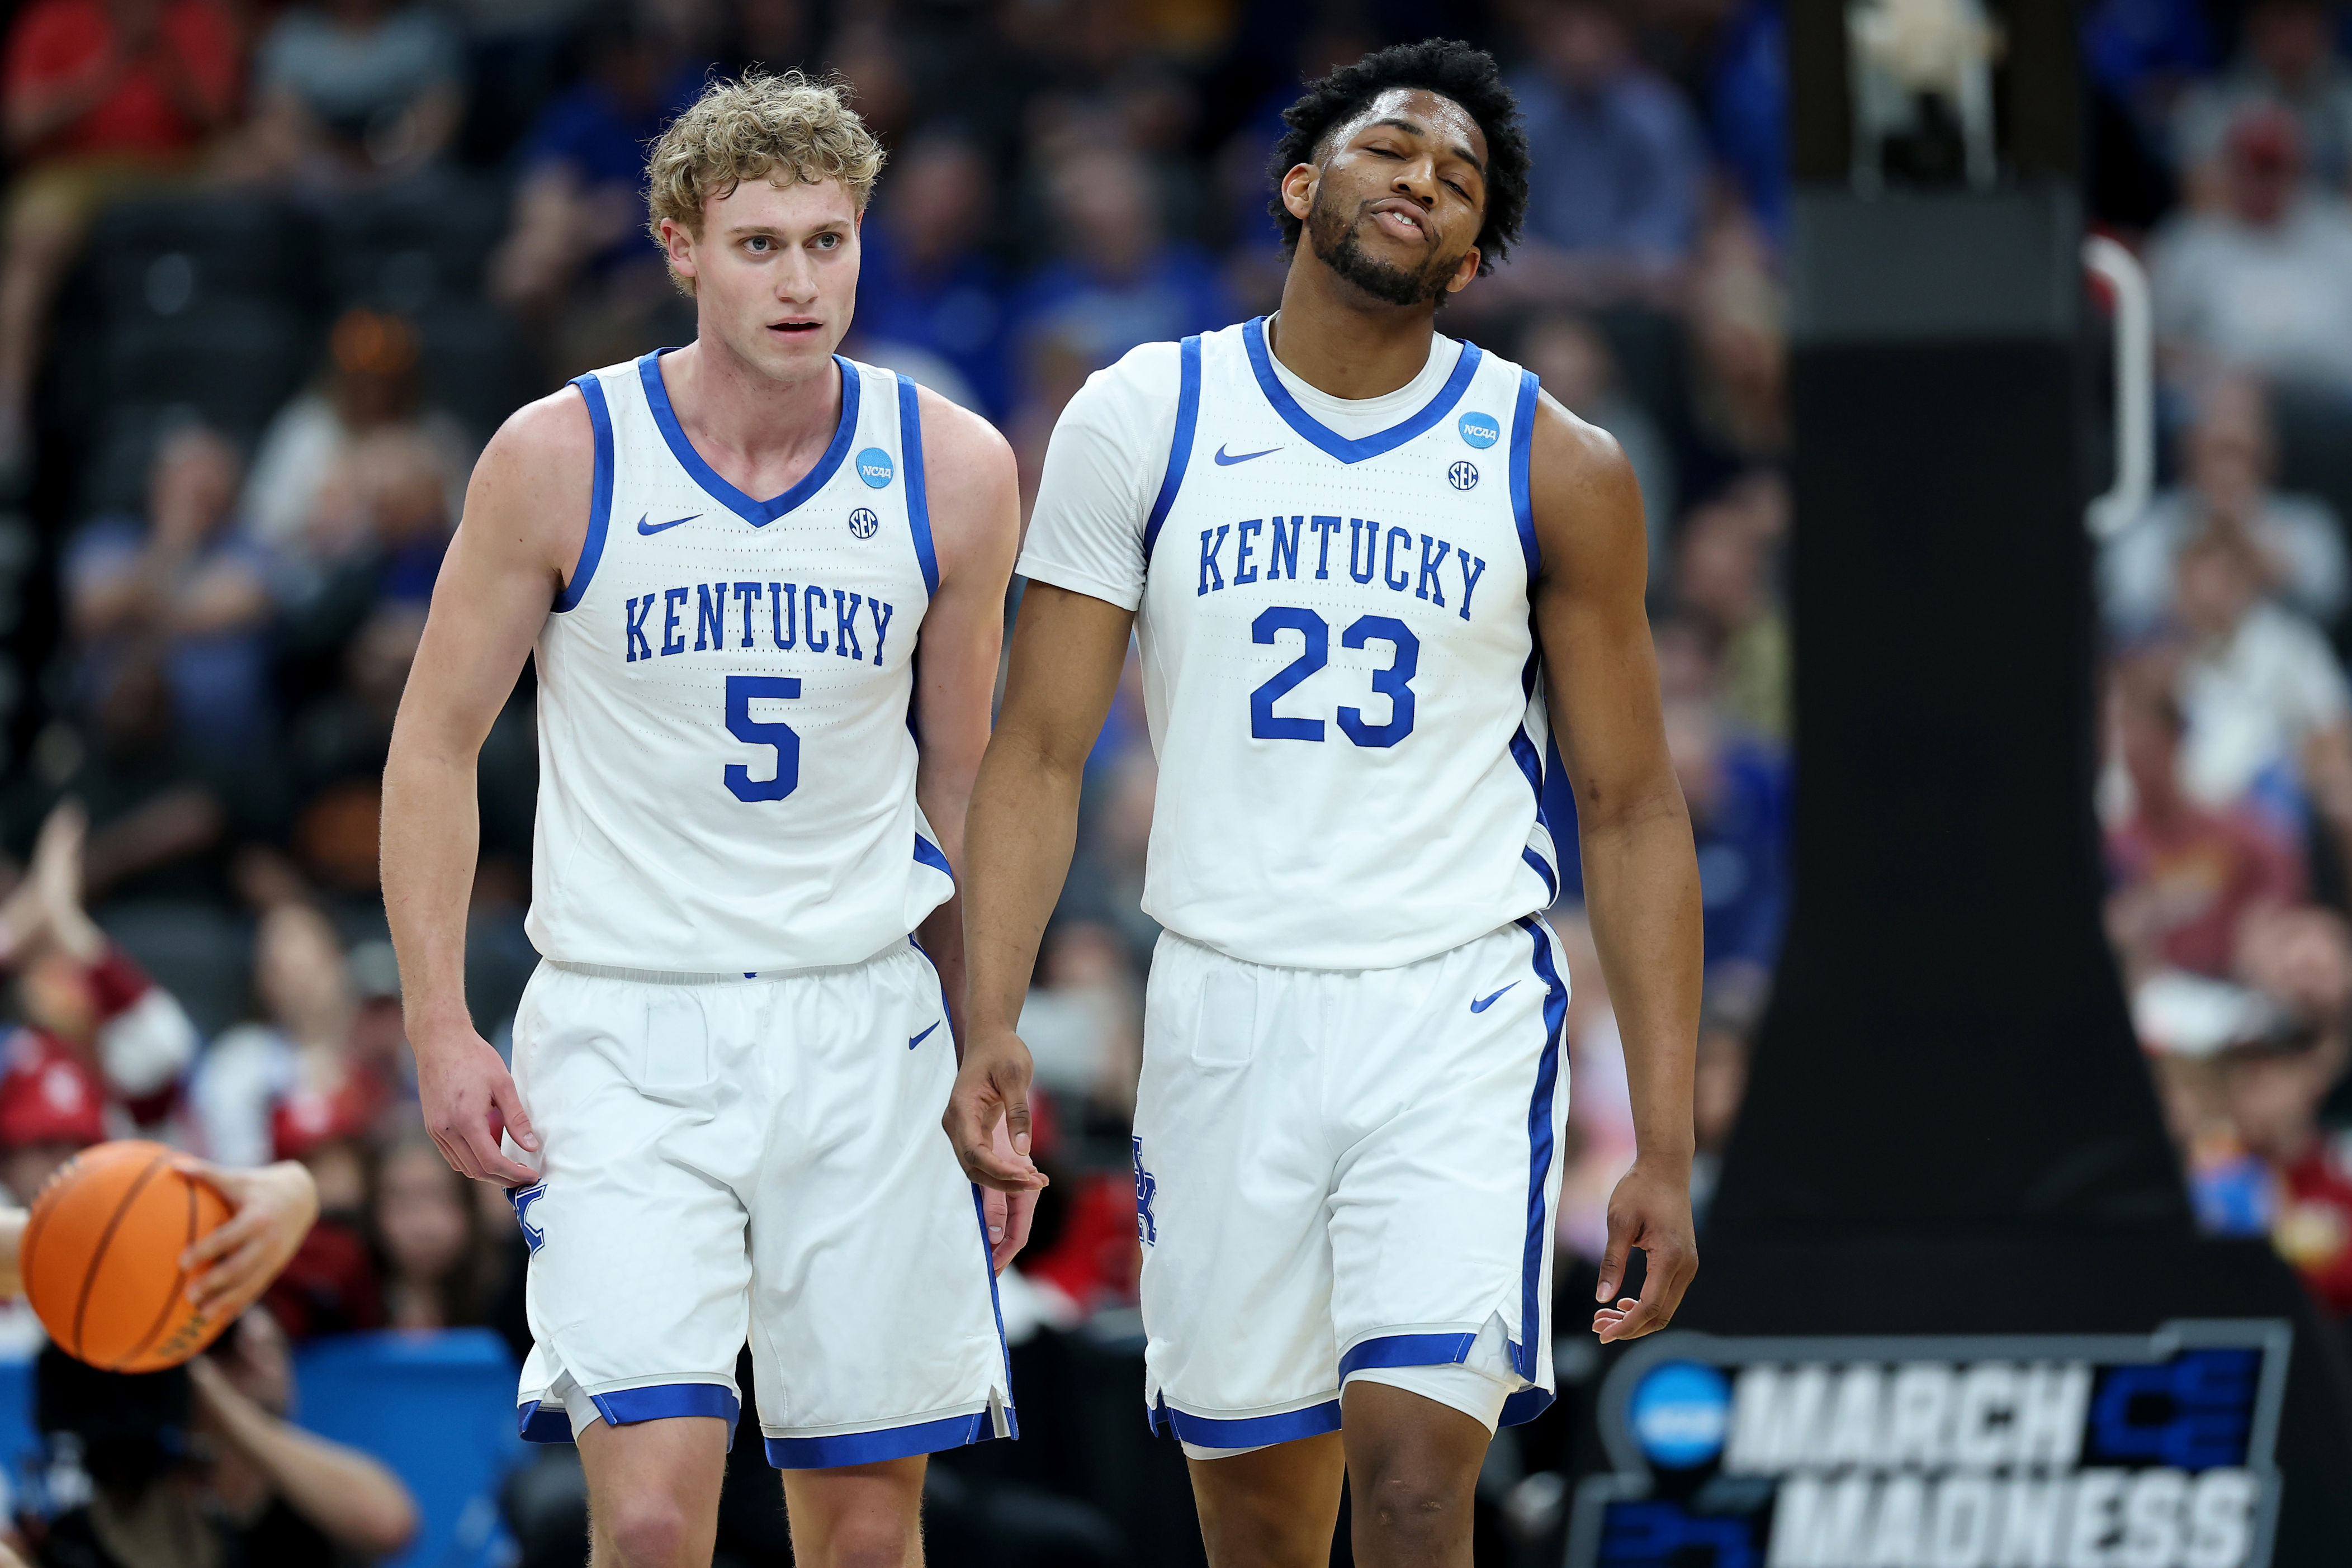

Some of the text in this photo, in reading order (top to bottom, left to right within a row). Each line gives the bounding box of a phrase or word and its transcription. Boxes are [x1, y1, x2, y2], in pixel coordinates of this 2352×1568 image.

[863, 465, 892, 479] NCAA
[1450, 462, 1476, 489] SEC
[1464, 424, 1497, 440] NCAA
[850, 509, 876, 537] SEC
[1198, 515, 1485, 620] KENTUCKY
[626, 582, 893, 666] KENTUCKY
[1251, 607, 1419, 747] 23
[724, 675, 801, 802] 5
[1724, 1361, 2094, 1476] MARCH
[1766, 1468, 2260, 1568] MADNESS
